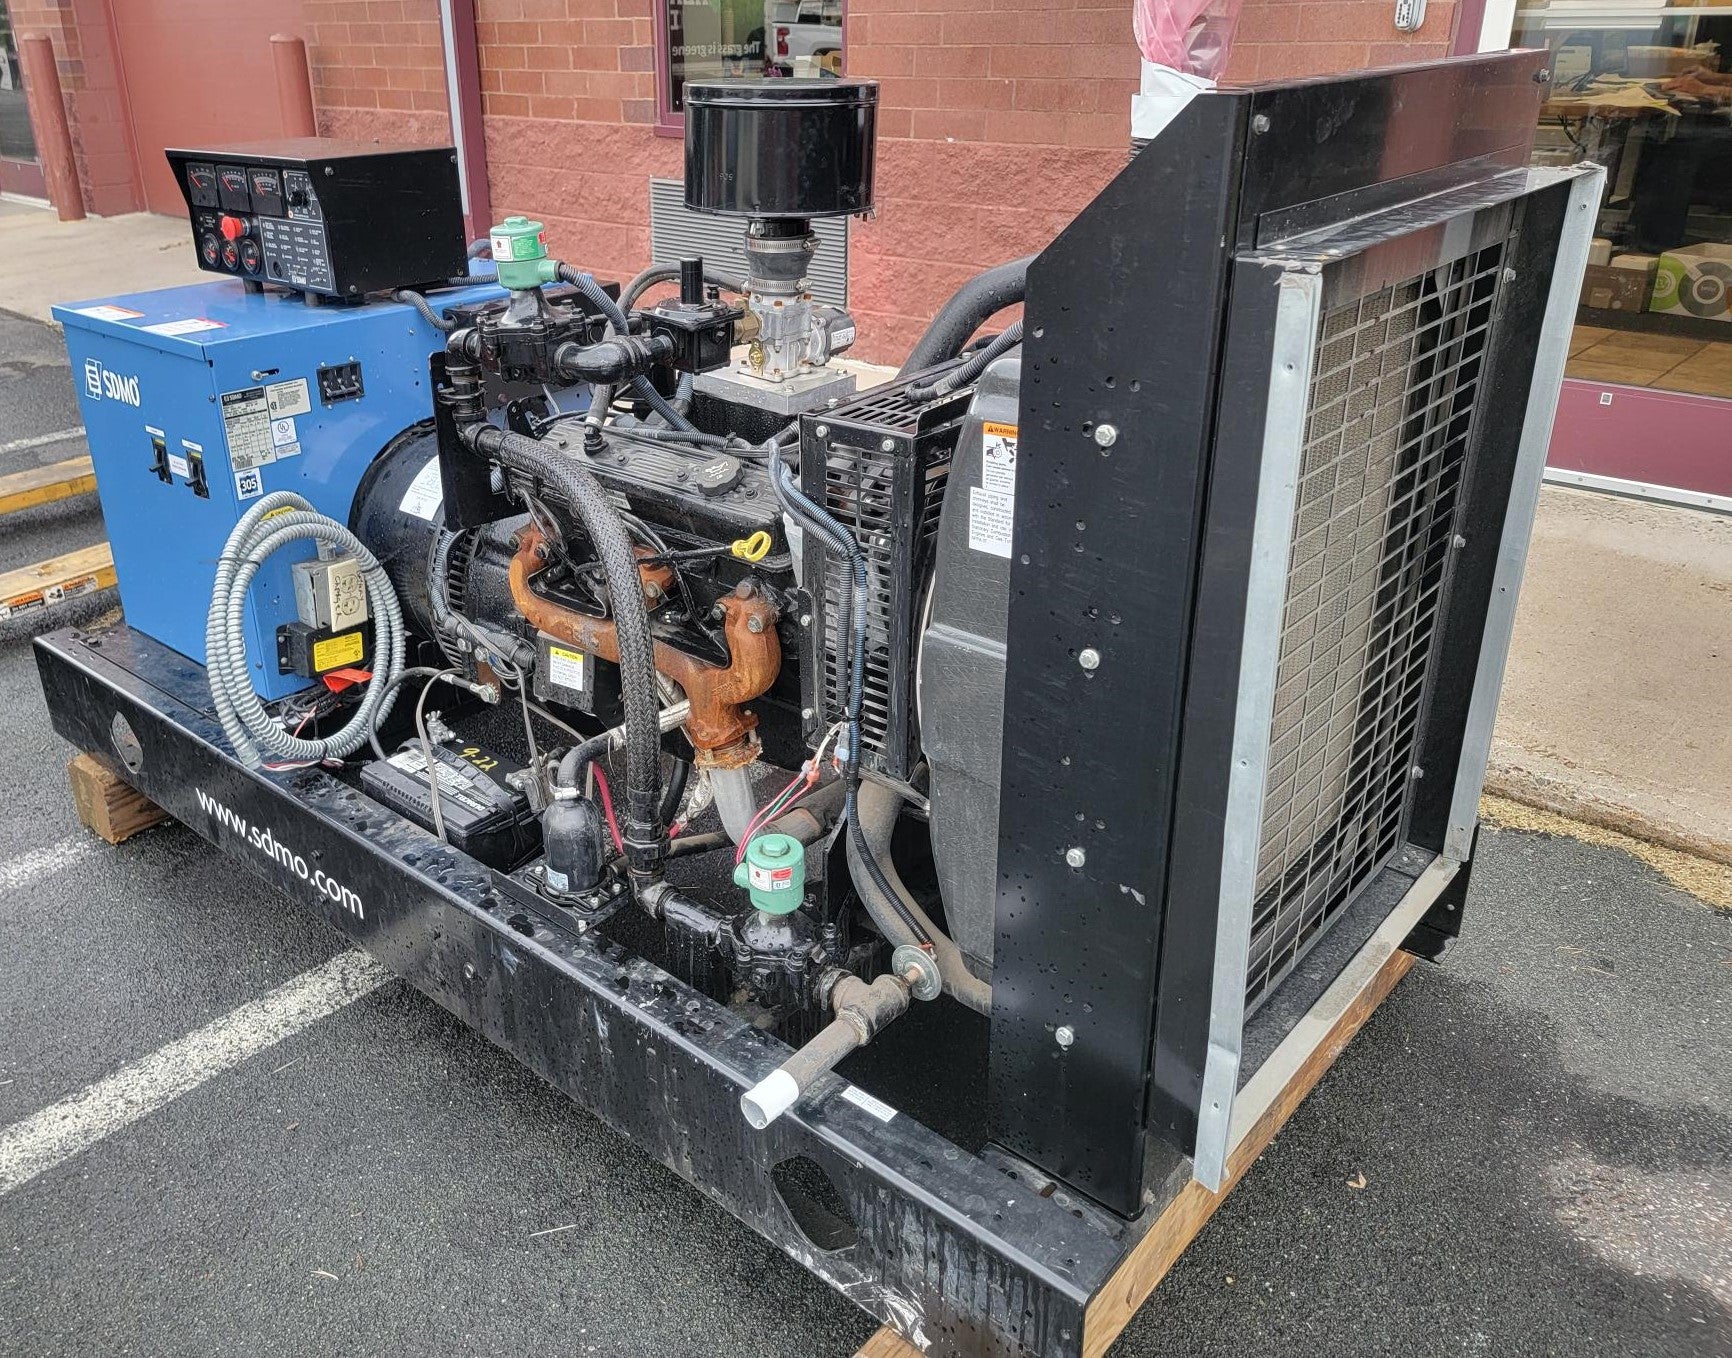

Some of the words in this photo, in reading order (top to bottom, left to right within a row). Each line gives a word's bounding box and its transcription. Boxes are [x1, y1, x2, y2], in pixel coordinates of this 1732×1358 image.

[103, 369, 141, 408] SDMO
[994, 427, 1017, 437] WARNIN
[240, 478, 257, 492] 305
[195, 787, 364, 920] www.sdmo.com
